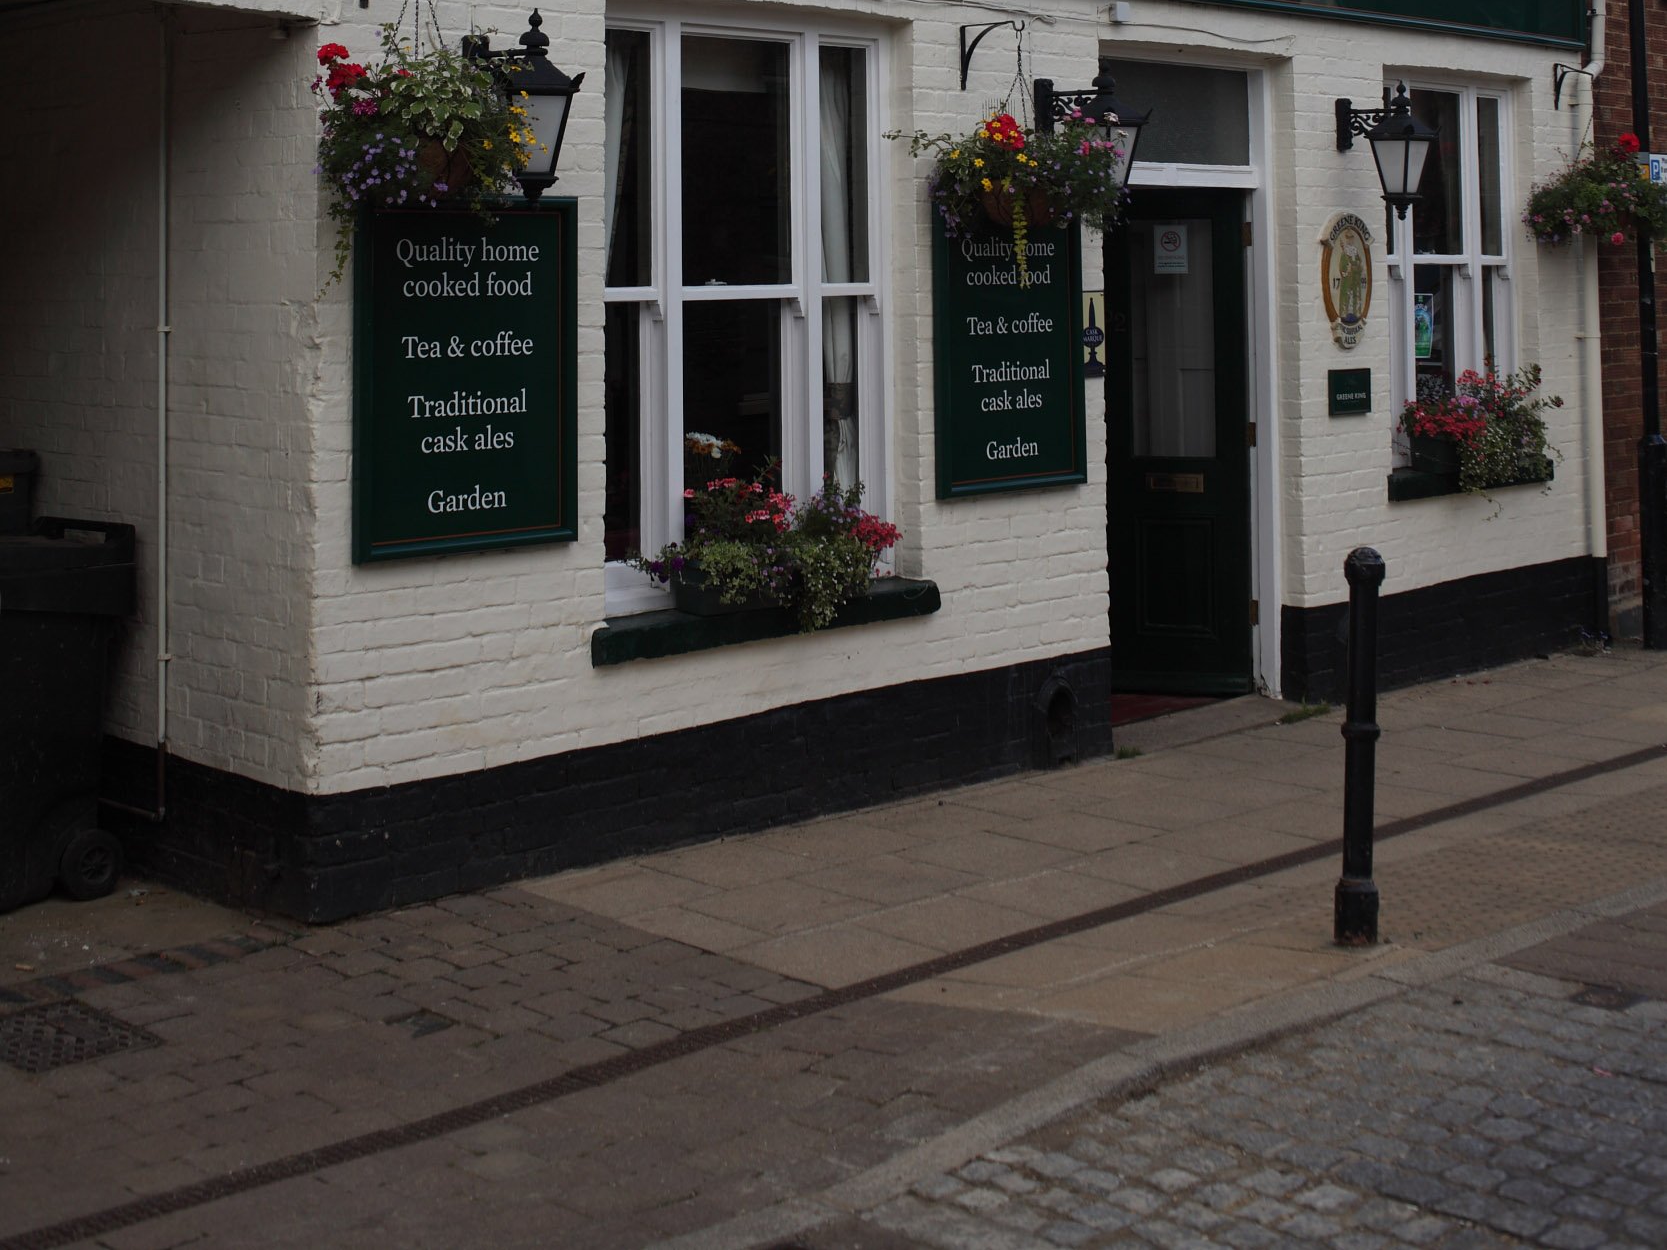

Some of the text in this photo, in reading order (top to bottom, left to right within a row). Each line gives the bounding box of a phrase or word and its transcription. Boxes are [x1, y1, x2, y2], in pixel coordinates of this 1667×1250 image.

[1329, 215, 1371, 241] GREENE KING
[396, 237, 540, 268] Quality home
[961, 238, 1055, 261] Quality ome
[403, 271, 533, 298] cooked food
[966, 264, 1051, 286] cooked ood
[967, 312, 1053, 335] Tea & coffee
[1085, 328, 1099, 336] CASK
[401, 331, 534, 359] Tea & coffee
[971, 359, 1050, 383] Traditional
[407, 388, 528, 419] Traditional
[981, 388, 1042, 412] cask ales
[1336, 392, 1354, 401] GREENE
[421, 425, 515, 454] cask ales
[986, 437, 1039, 460] Garden
[428, 485, 507, 514] Garden
